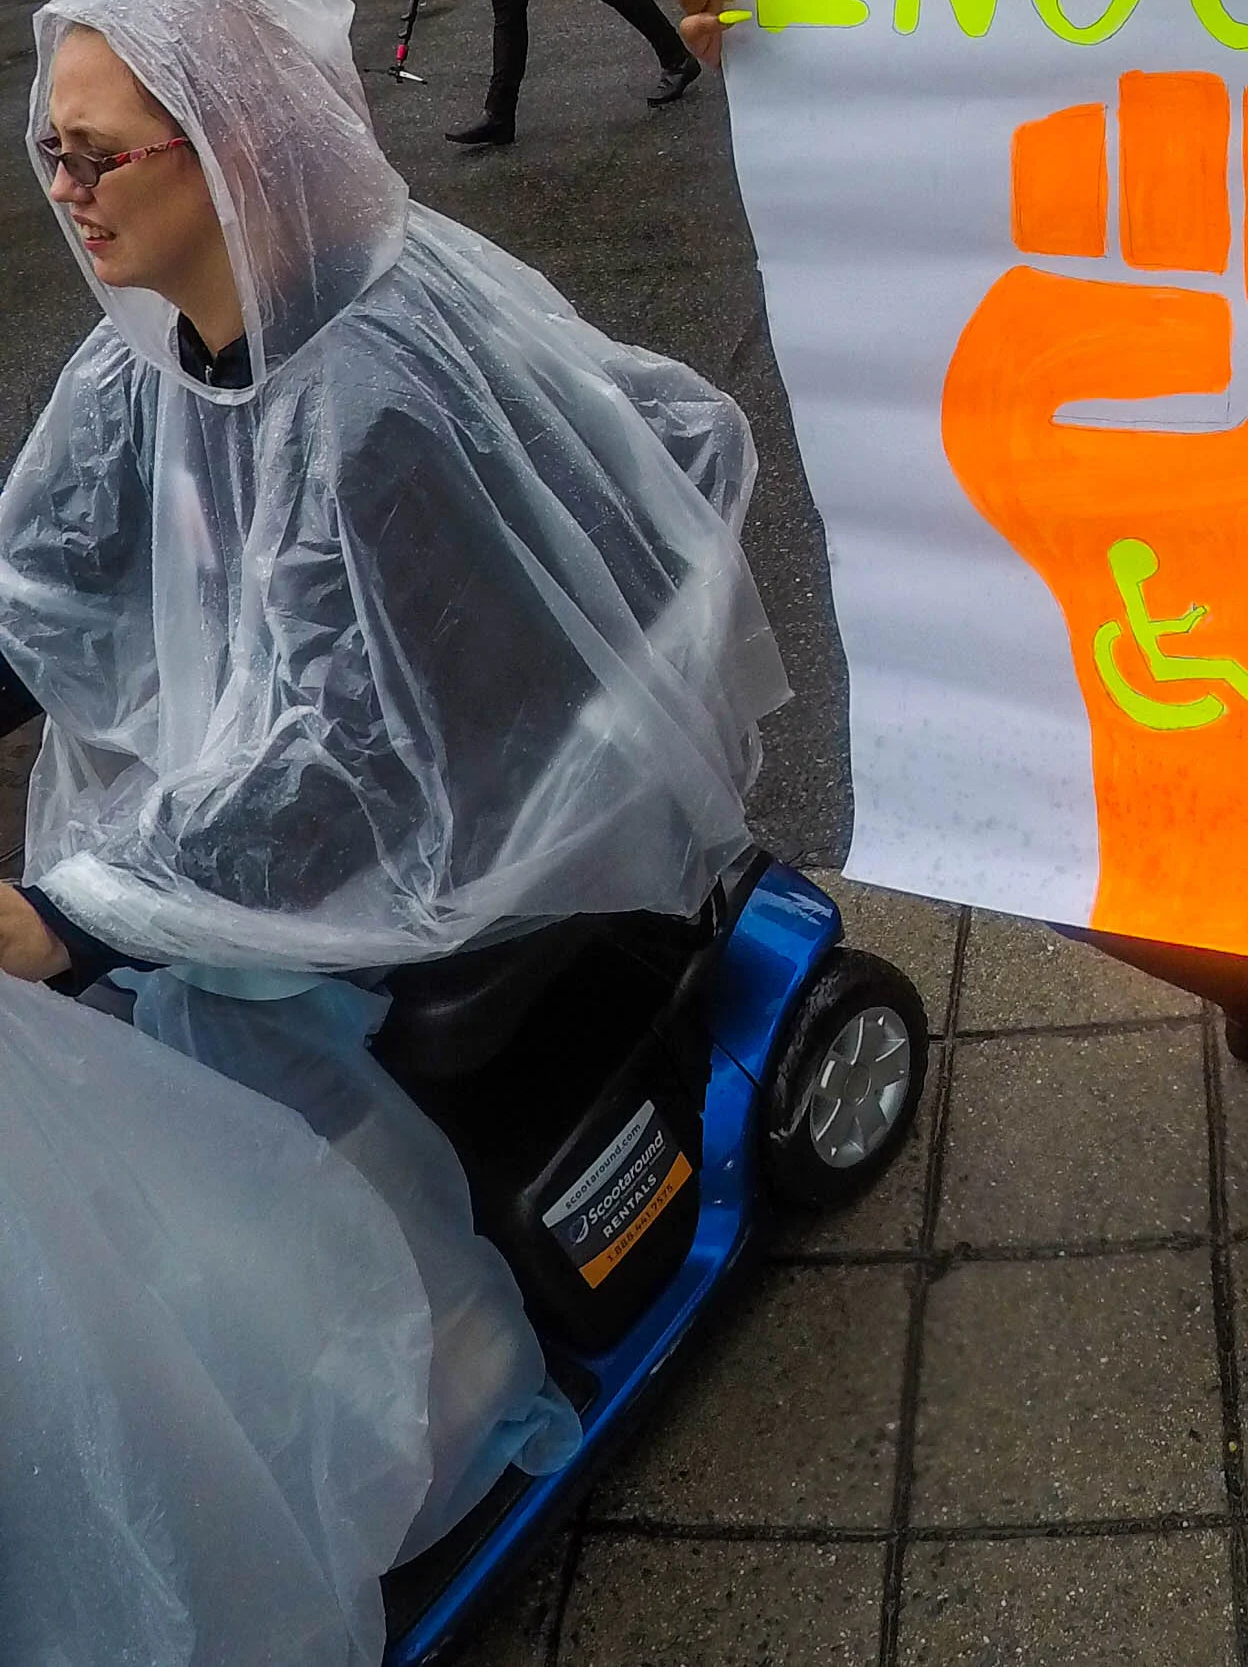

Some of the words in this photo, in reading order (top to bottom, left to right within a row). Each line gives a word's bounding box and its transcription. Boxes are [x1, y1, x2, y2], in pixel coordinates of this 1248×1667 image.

[565, 1123, 641, 1210] scootaround.com
[588, 1130, 664, 1225] Scootaround
[602, 1173, 658, 1239] RENTALS
